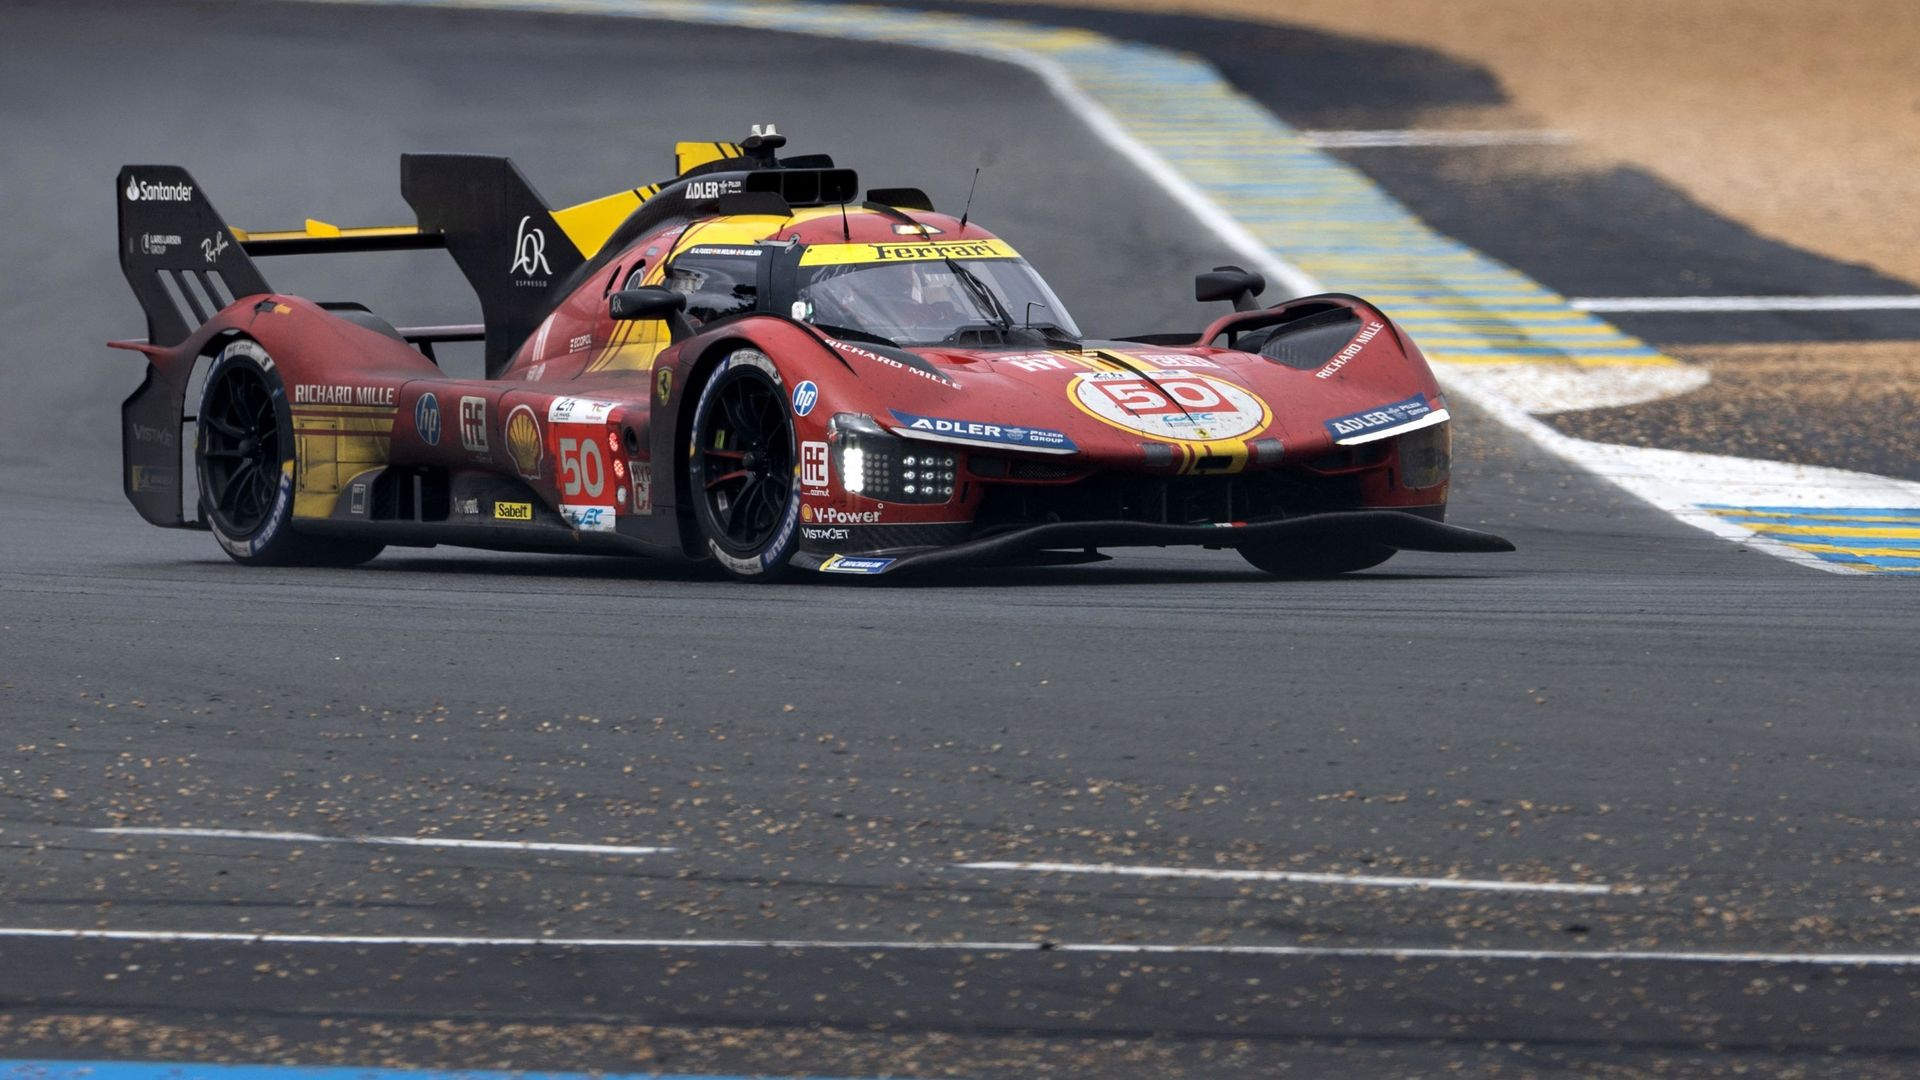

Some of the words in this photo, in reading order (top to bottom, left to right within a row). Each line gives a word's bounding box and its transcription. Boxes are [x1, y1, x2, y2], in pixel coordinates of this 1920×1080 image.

[140, 181, 192, 201] Santander
[685, 181, 719, 199] ADLER
[868, 239, 1000, 261] Ferrari
[516, 279, 547, 287] ESPRESSO
[1316, 343, 1362, 380] RICHARD
[1358, 321, 1384, 347] MILLE
[824, 338, 902, 369] RICHARD
[908, 366, 963, 390] MILLE
[295, 384, 352, 404] RICHARD
[355, 386, 395, 406] MILLE
[794, 381, 817, 415] hp
[1102, 381, 1220, 410] 50
[418, 394, 438, 445] hp
[911, 418, 1001, 437] ADLER
[1333, 411, 1396, 435] ADLER
[559, 438, 604, 498] 50
[498, 503, 527, 518] Sabelt
[813, 507, 881, 523] V-Power
